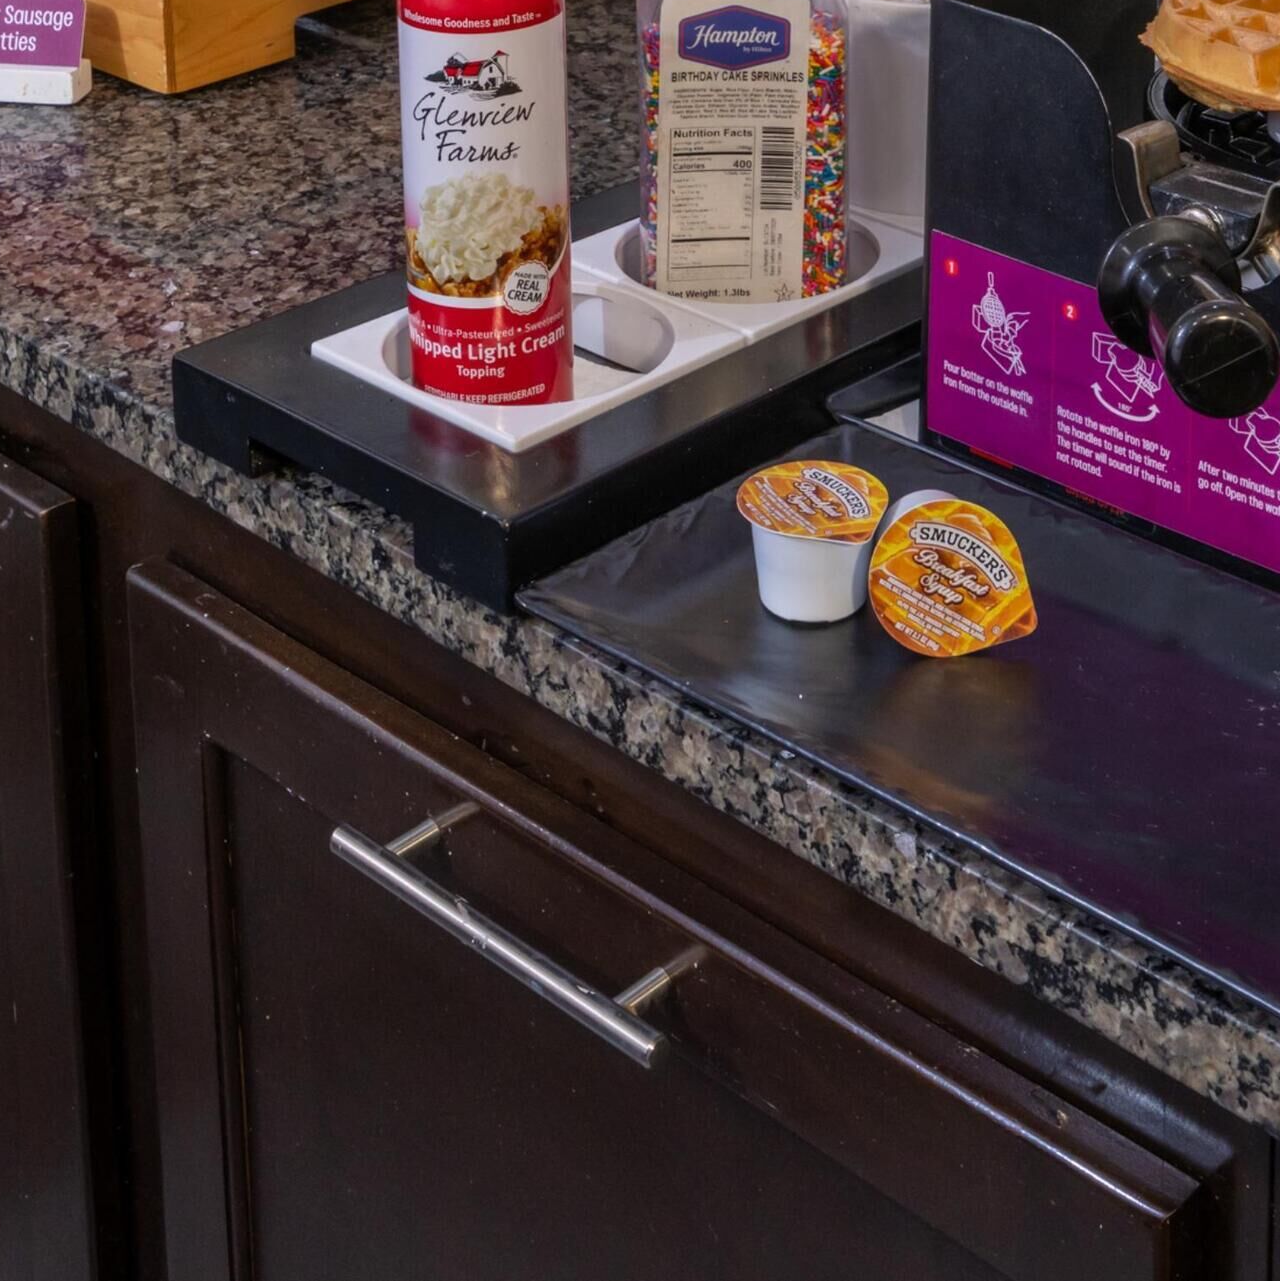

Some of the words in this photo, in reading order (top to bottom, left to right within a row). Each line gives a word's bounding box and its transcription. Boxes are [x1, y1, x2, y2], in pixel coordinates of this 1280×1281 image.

[4, 4, 74, 29] Sausage
[403, 7, 443, 28] Wholesome
[443, 17, 491, 29] Goodness
[492, 15, 511, 28] and
[512, 11, 535, 25] Taste
[686, 23, 780, 50] Hampton
[671, 71, 719, 83] BIRTHDAY
[721, 71, 749, 82] CAKE
[751, 71, 805, 83] SPRINKLES
[412, 91, 536, 141] Glenview
[435, 129, 522, 162] Farms
[673, 129, 721, 140] Nutrition
[723, 128, 754, 138] Facts
[672, 162, 706, 171] Calories
[733, 160, 753, 169] 400
[507, 290, 542, 302] CREAM
[516, 279, 540, 291] REAL
[685, 289, 720, 299] Weight:
[724, 288, 751, 297] 1.3lbs
[468, 342, 517, 364] Light
[521, 324, 565, 355] Cream
[456, 365, 505, 379] Topping
[943, 359, 960, 375] Pour
[960, 366, 985, 385] batter
[996, 381, 1010, 396] the
[1010, 387, 1034, 405] waffle
[488, 383, 546, 404] REFRIGERATED
[943, 373, 958, 389] iron
[958, 380, 977, 397] from
[977, 388, 991, 403] the
[990, 395, 1019, 414] outside
[1056, 405, 1083, 425] Rotate
[1084, 416, 1099, 431] the
[1099, 423, 1124, 441] waffle
[1124, 431, 1141, 448] iron
[1159, 444, 1171, 461] by
[1056, 420, 1071, 435] the
[1071, 425, 1103, 448] handles
[1103, 439, 1113, 452] to
[1113, 444, 1127, 458] set
[1127, 448, 1142, 463] the
[1143, 455, 1168, 473] timer.
[1056, 434, 1071, 450] The
[1072, 441, 1094, 459] timer
[1094, 451, 1108, 465] will
[1108, 457, 1133, 475] sound
[1141, 469, 1156, 485] the
[1156, 474, 1173, 491] iron
[1056, 451, 1070, 464] not
[1070, 456, 1103, 478] rotated.
[1197, 477, 1209, 490] go
[1224, 485, 1248, 504] Open
[1248, 495, 1264, 510] the
[1198, 460, 1221, 477] After
[1221, 469, 1239, 484] two
[1239, 476, 1275, 499] minutes
[919, 526, 1009, 584] SMUCKER'S
[914, 549, 990, 597] Breakfast
[920, 572, 964, 605] Syrup
